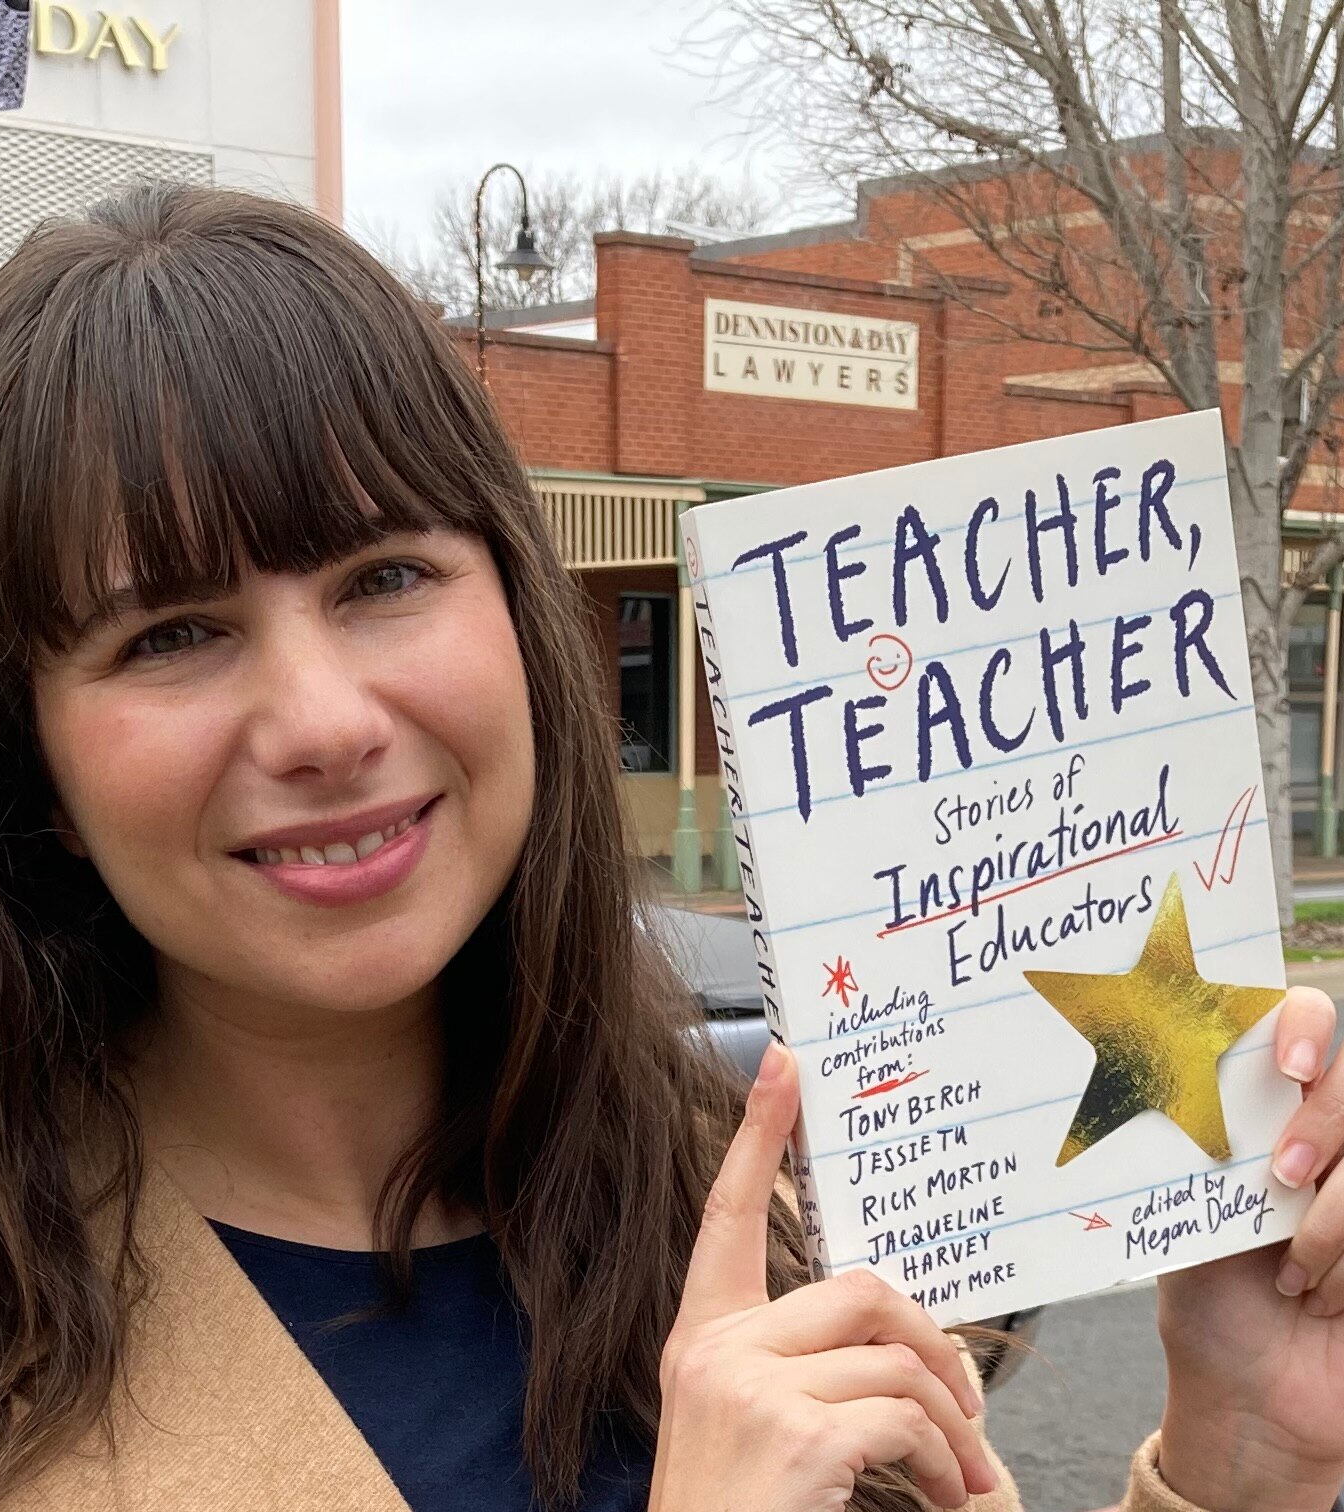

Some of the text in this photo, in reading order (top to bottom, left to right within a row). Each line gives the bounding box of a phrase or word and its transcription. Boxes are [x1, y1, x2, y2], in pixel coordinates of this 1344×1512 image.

[714, 311, 845, 350] DENNISTON
[867, 329, 912, 355] DAY
[712, 352, 910, 396] LAWYERS
[731, 459, 1202, 668] TEACHER,
[695, 584, 744, 819] TEACHER,
[748, 589, 1238, 824] TEACHER
[933, 753, 1086, 845] Stories of
[872, 763, 1180, 930] Inspirational
[946, 875, 1153, 987] Educators
[827, 985, 936, 1041] including
[820, 1017, 946, 1077] contributions
[856, 1053, 914, 1090] from:
[839, 1079, 982, 1142] TONY BIRCH
[847, 1125, 968, 1186] JESSIE TU
[861, 1151, 1017, 1227] RICK MORTON
[1131, 1171, 1226, 1226] edited by
[867, 1195, 1005, 1266] JACQUELINE
[1125, 1183, 1275, 1260] Megan Daley
[902, 1230, 992, 1282] HARVEY
[909, 1262, 1016, 1310] MANY MORE
